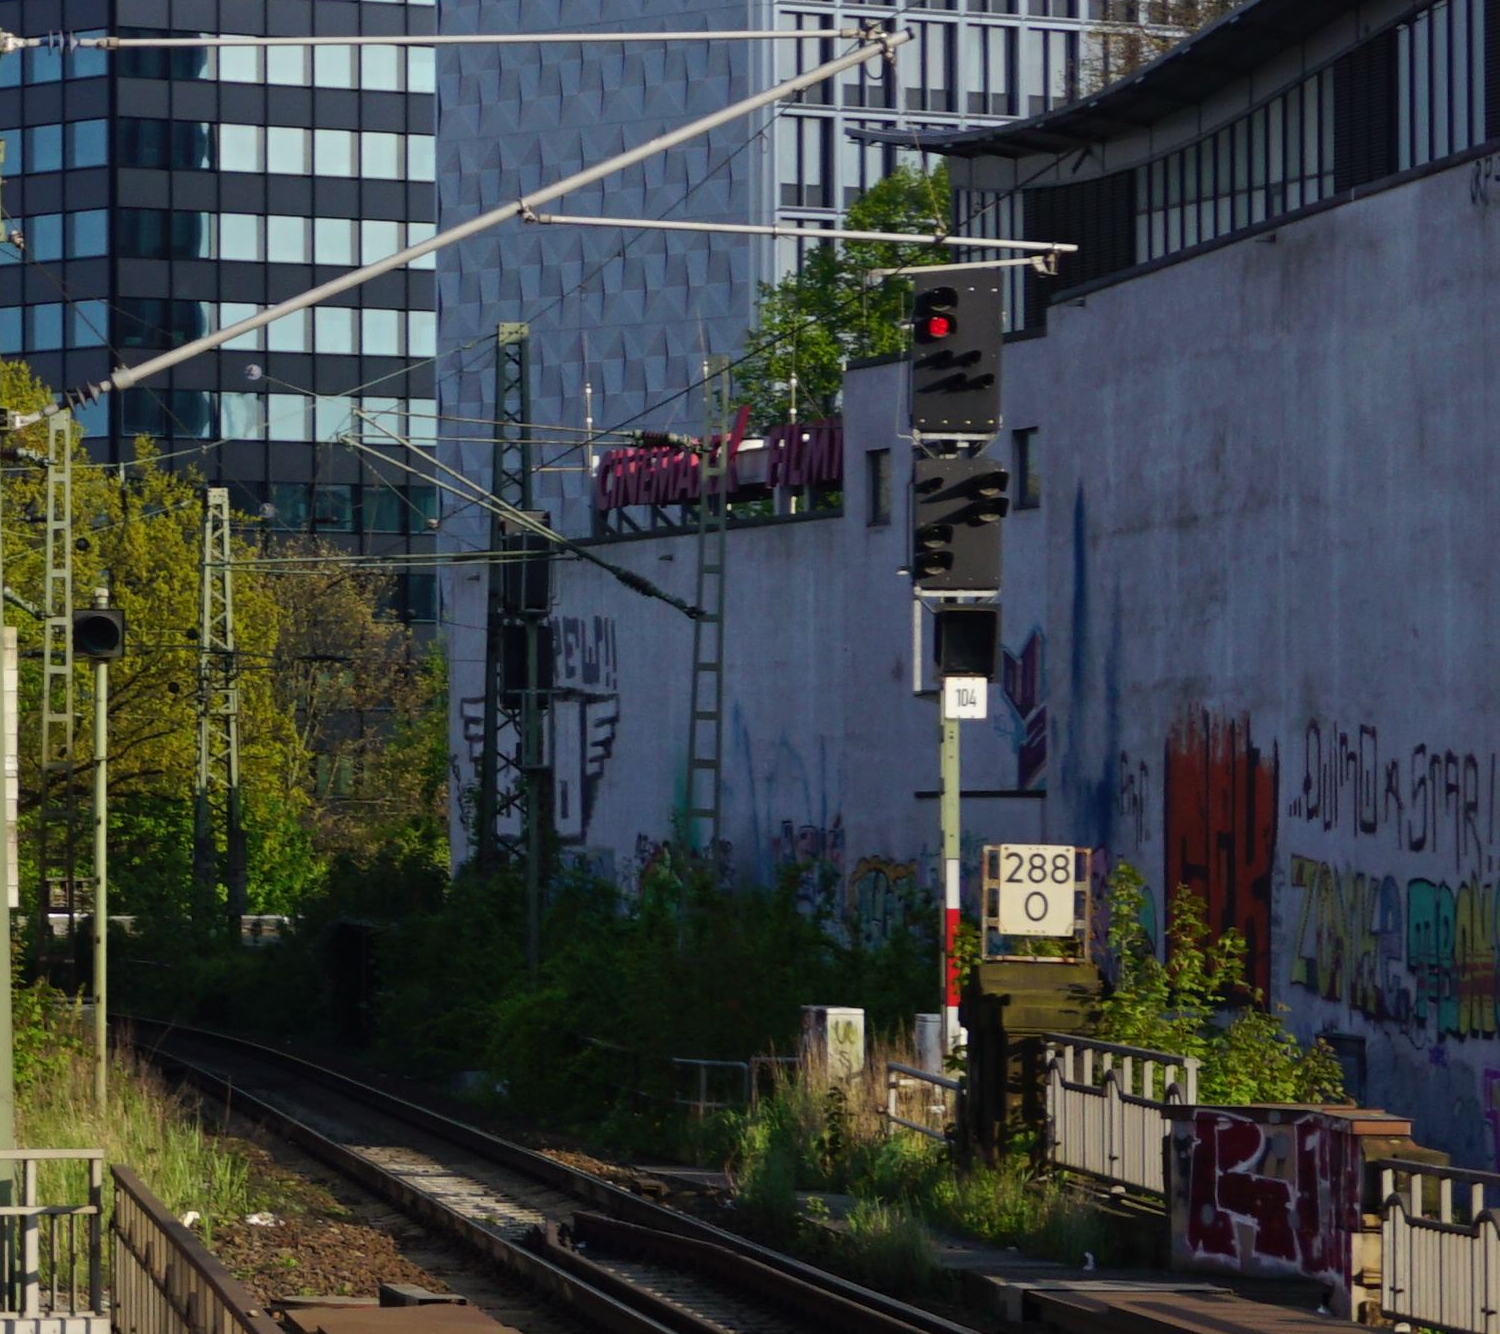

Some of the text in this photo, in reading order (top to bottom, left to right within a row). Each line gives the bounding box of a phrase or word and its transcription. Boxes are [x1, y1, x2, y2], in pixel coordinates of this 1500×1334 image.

[955, 688, 977, 708] 104
[1004, 851, 1071, 885] 288
[1024, 891, 1049, 922] 0
